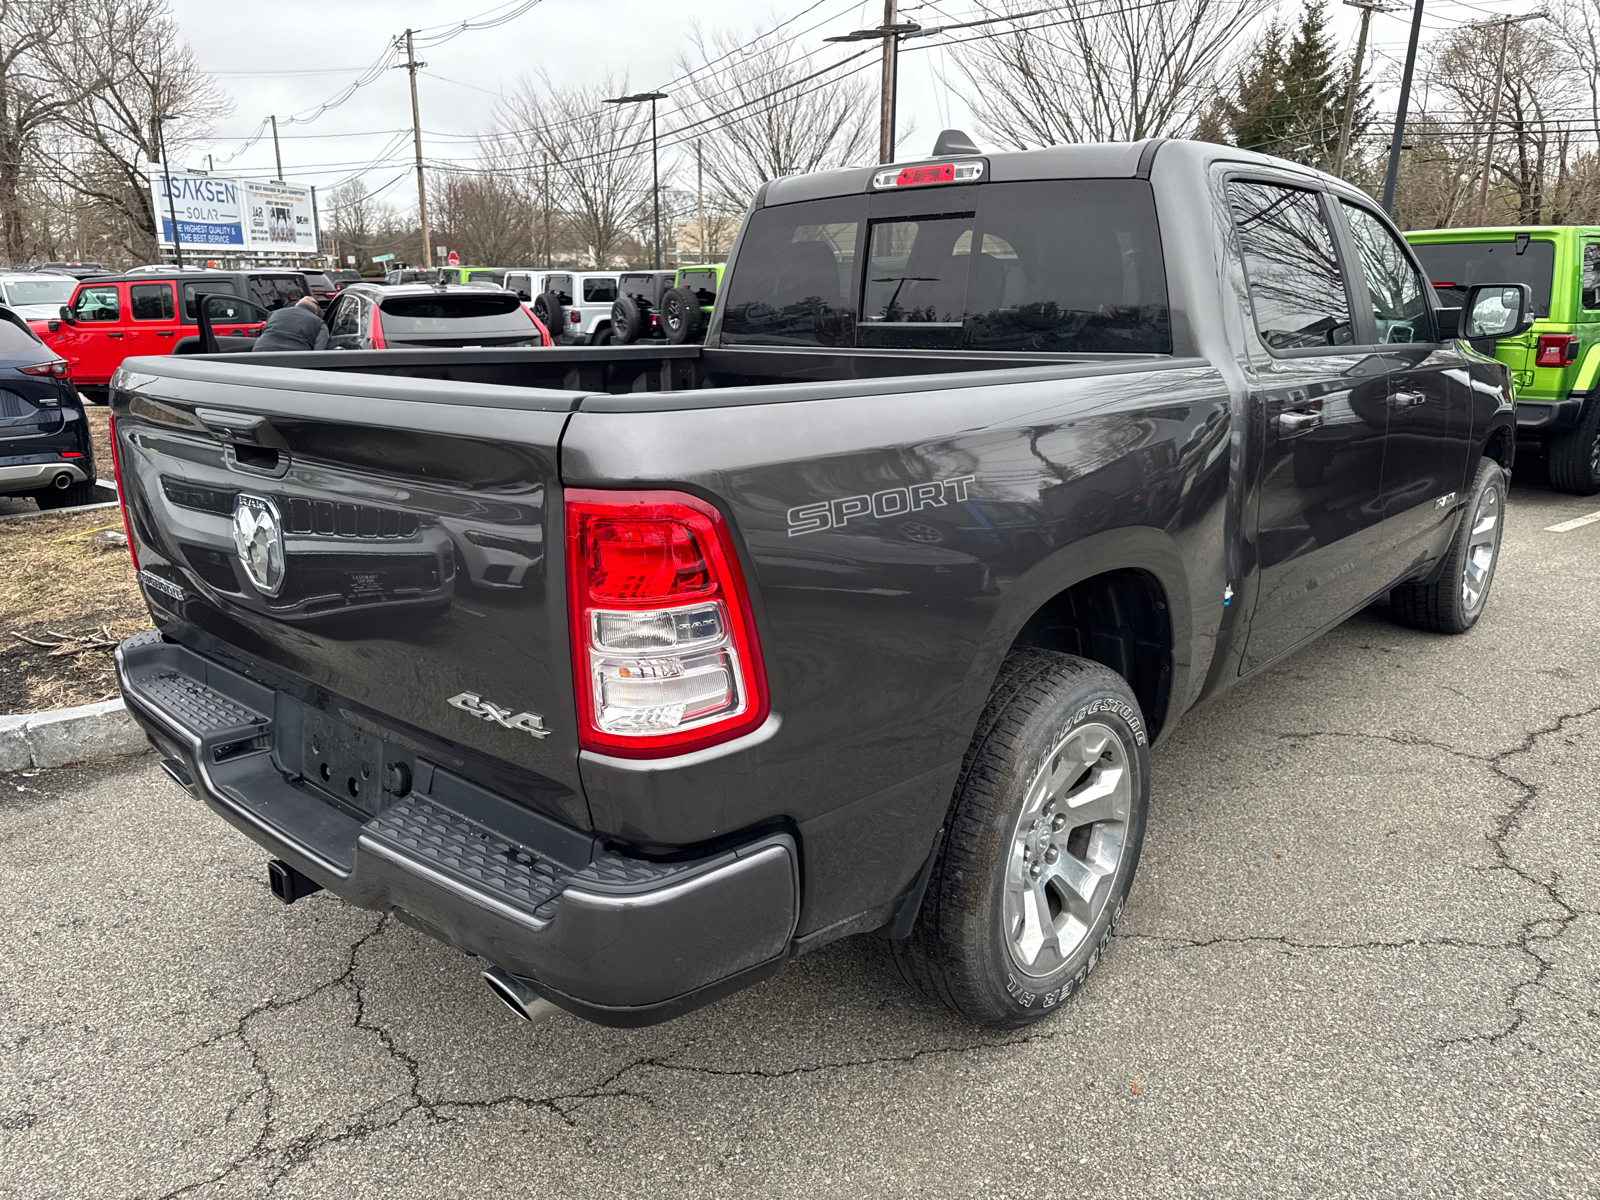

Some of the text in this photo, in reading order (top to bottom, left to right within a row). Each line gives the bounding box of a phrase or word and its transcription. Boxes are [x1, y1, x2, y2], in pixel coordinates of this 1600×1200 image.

[159, 174, 236, 204] ISAKSEN
[186, 207, 218, 220] SOLAR
[184, 224, 208, 234] HIGHEST
[208, 226, 230, 234] QUALITY
[180, 233, 230, 244] THE BEST SERVICE
[239, 496, 266, 510] RAM
[787, 474, 976, 538] SPORT
[678, 618, 714, 629] RAM
